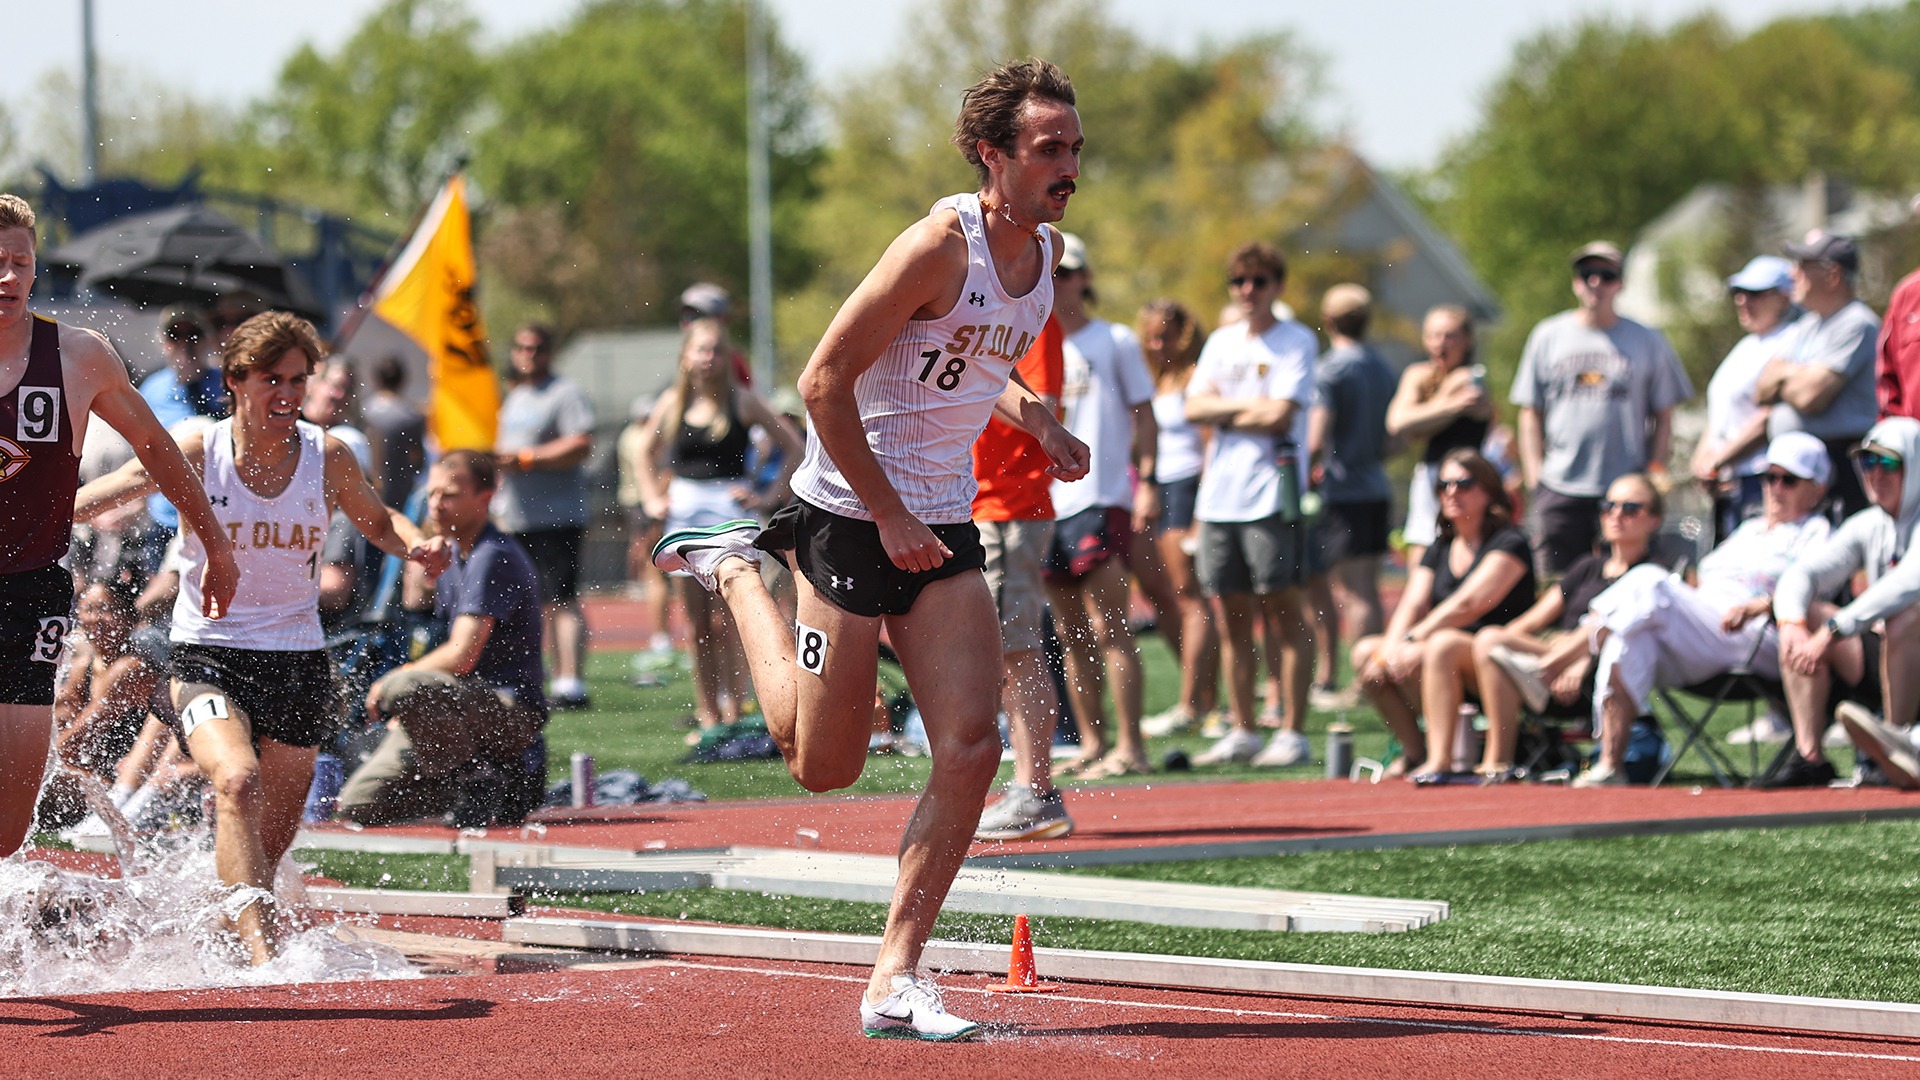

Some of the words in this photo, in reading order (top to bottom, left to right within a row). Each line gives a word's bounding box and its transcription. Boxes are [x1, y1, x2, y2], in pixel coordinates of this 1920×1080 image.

[945, 324, 991, 356] ST.
[918, 348, 966, 391] 18
[23, 390, 54, 439] 9
[226, 522, 246, 550] T.
[252, 521, 321, 550] OLAF
[40, 619, 64, 660] 9
[183, 698, 217, 726] 11
